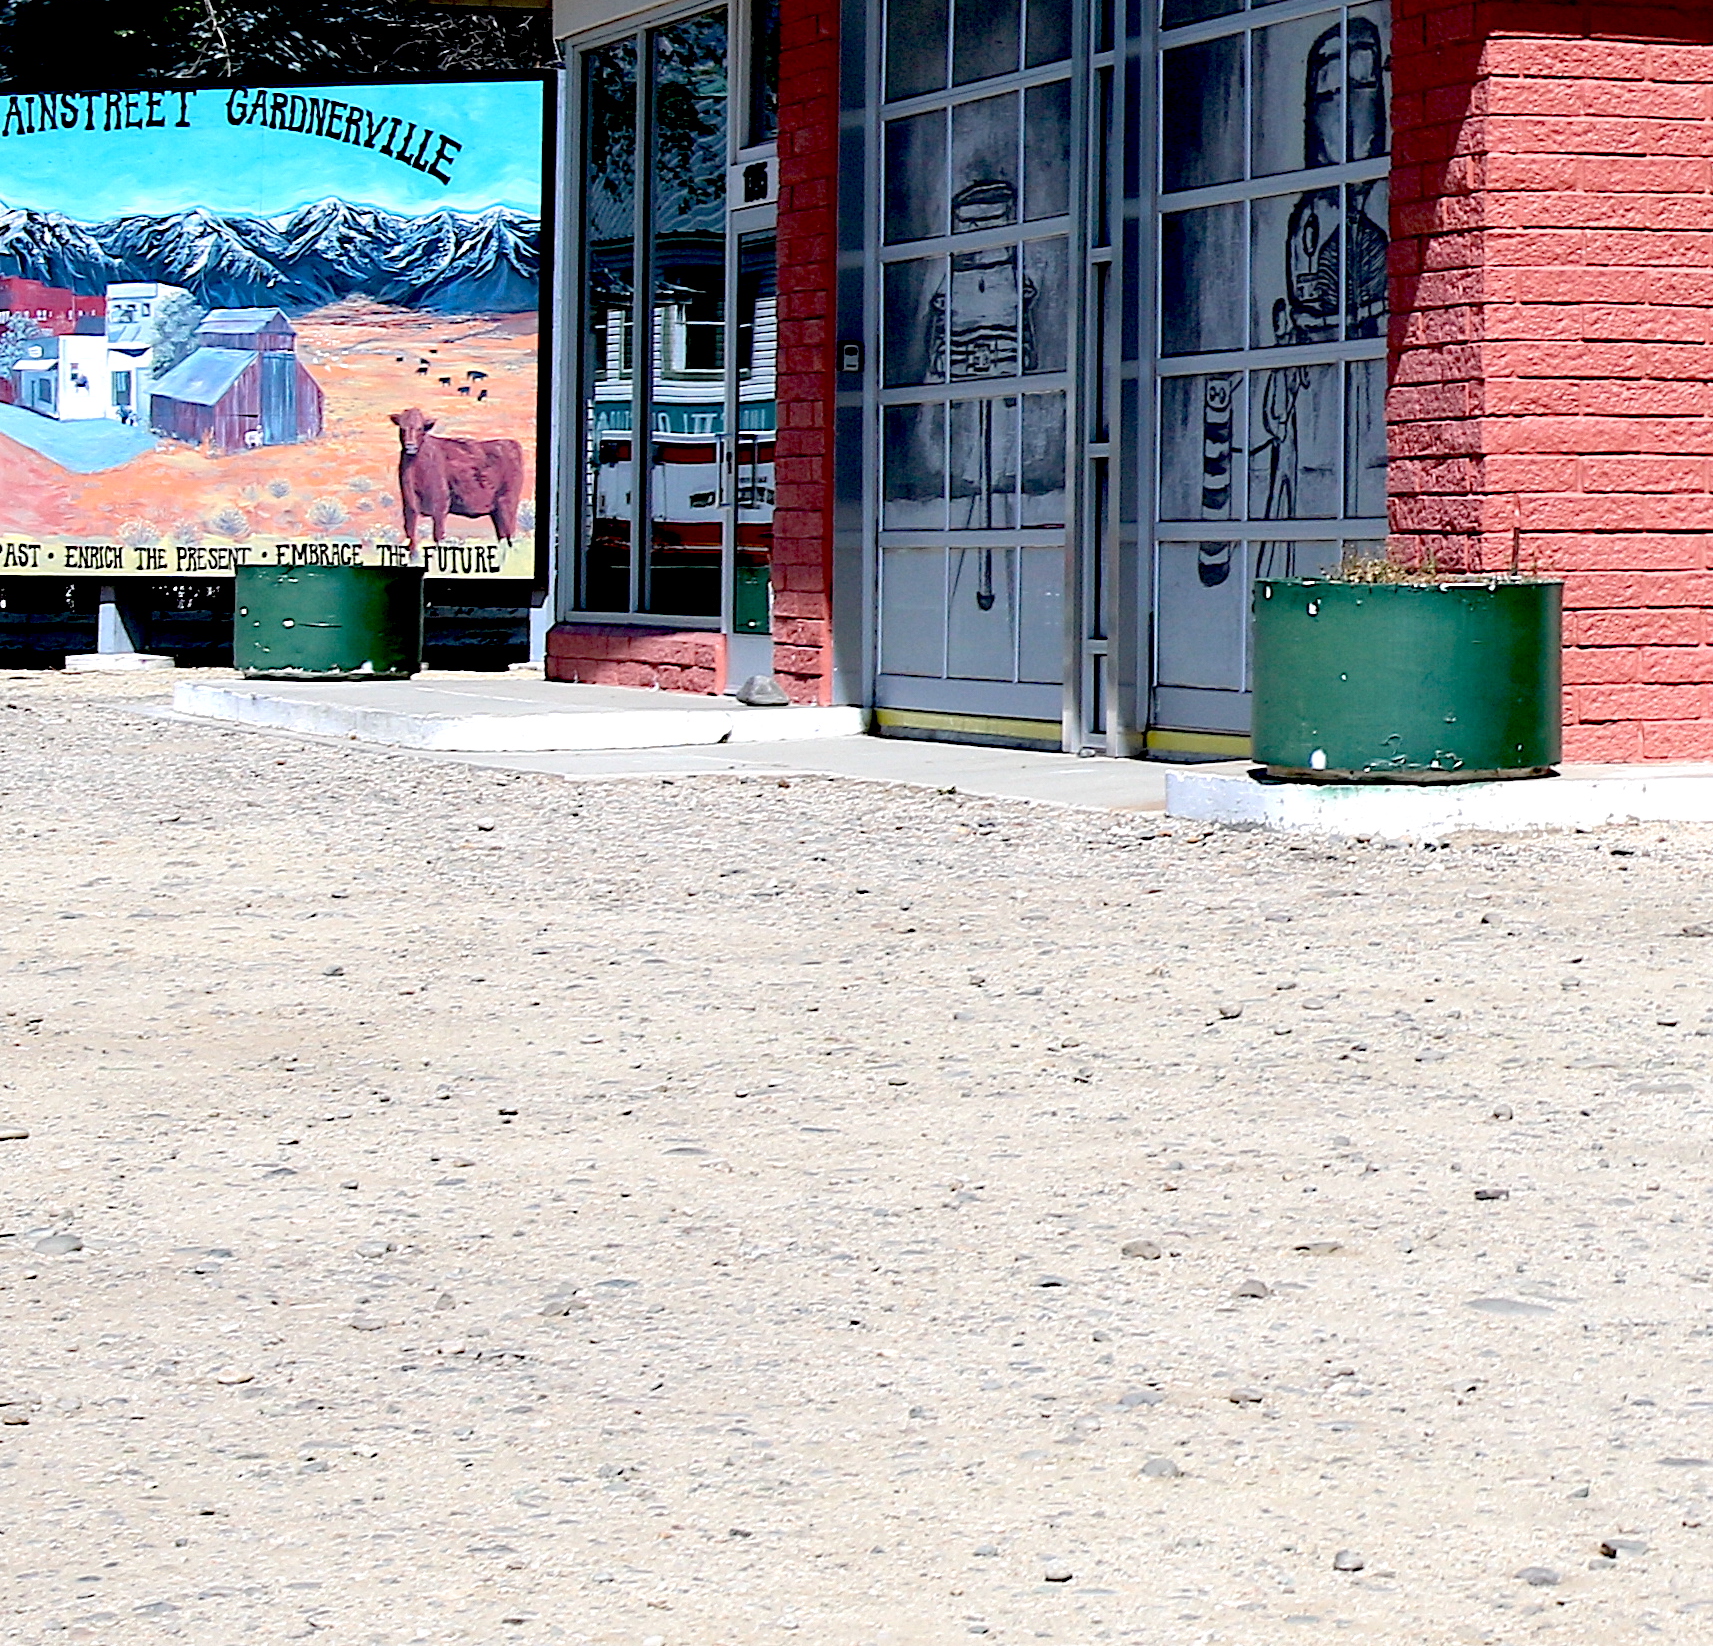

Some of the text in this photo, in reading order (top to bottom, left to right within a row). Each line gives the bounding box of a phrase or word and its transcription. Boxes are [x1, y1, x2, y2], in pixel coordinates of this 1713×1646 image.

[1, 85, 463, 186] AINSTREET GARDNERVILLE
[0, 543, 500, 573] AST ENRICH THE PRESENT EMBRACE THE FUTURE
